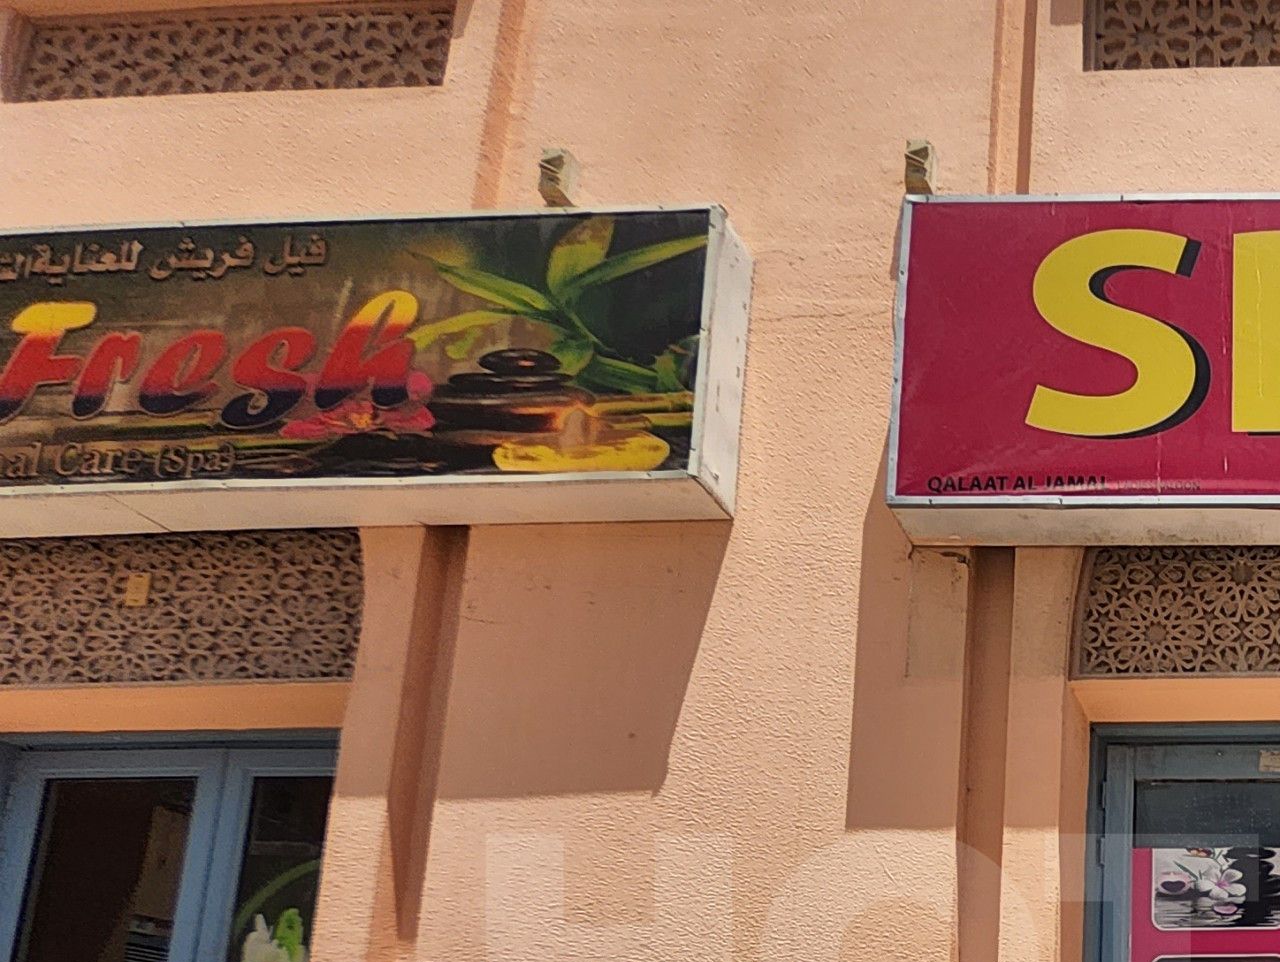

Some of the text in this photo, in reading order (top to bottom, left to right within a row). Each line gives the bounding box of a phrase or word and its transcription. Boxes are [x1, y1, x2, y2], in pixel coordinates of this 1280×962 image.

[29, 239, 144, 286] للعناية
[149, 235, 254, 281] فريش
[263, 234, 327, 276] فيل
[0, 288, 420, 430] Fresh
[54, 442, 146, 477] Care
[151, 440, 237, 479] (Spa)
[927, 476, 1009, 493] QALAAT
